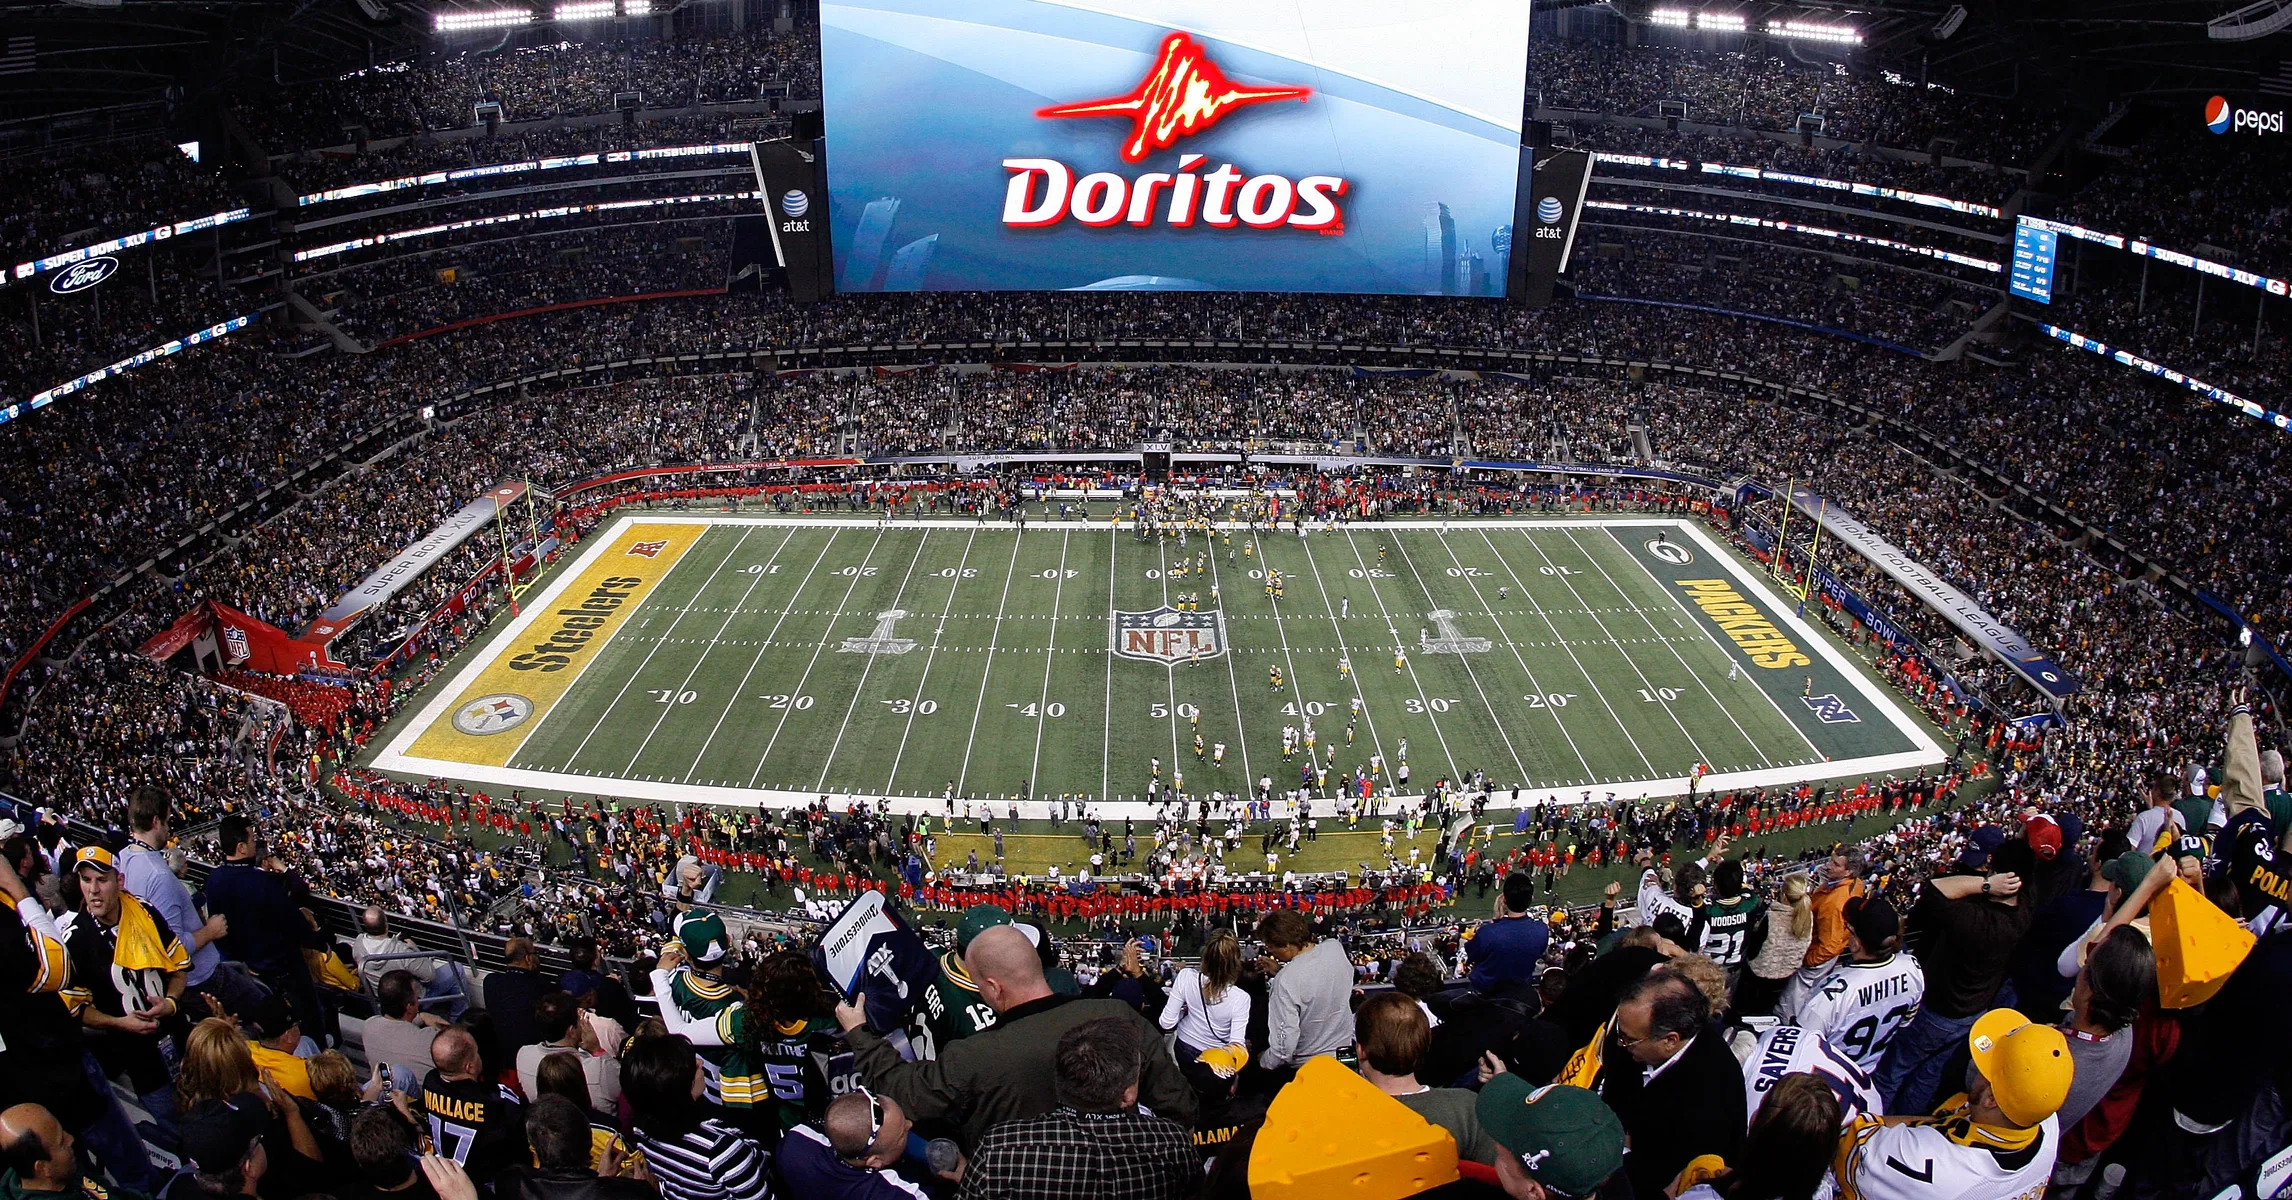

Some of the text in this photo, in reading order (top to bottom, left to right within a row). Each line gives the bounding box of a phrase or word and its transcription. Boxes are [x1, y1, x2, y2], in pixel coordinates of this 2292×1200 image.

[2234, 108, 2284, 136] pepsi
[638, 144, 713, 160] PITTSBURGH
[1596, 152, 1651, 166] PACKERS
[449, 161, 537, 180] NORTH TEXAS 02.06.11
[1762, 171, 1788, 181] NORTH
[1789, 174, 1814, 185] TEXAS
[1002, 154, 1348, 230] Doritos
[782, 219, 810, 233] at&t
[1535, 226, 1562, 240] at&t
[44, 249, 86, 271] SUPER
[89, 239, 124, 258] BOWL
[123, 232, 147, 249] XLV
[62, 262, 108, 289] Ford
[2154, 249, 2193, 268] SUPER
[2196, 258, 2231, 278] BOWL
[2232, 269, 2259, 287] XLV
[1536, 464, 1563, 472] NATIONAL
[363, 513, 477, 596] SUPER BOWL XLV
[1823, 507, 2024, 655] NATIONAL FOOTBALL LEAGUE
[1811, 567, 1898, 642] SUPER BOWL
[508, 575, 642, 673] Steelers
[1674, 578, 1811, 669] PACKERS
[229, 639, 249, 659] NFL
[1126, 629, 1212, 656] NFL
[654, 689, 698, 705] 10
[768, 694, 815, 711] 20
[890, 699, 939, 716] 30
[1404, 697, 1452, 714] 30
[1522, 692, 1570, 709] 20
[1636, 686, 1679, 703] 10
[1019, 702, 1067, 718] 40
[1149, 702, 1196, 718] 50
[1279, 700, 1326, 717] 40
[2249, 864, 2290, 901] POLA
[829, 903, 880, 959] BRIDGESTONE
[1710, 912, 1747, 927] WOODSON
[1857, 973, 1909, 1008] WHITE
[965, 1003, 997, 1032] 12
[1841, 1002, 1910, 1062] 92
[1754, 1027, 1801, 1092] SAYERS
[424, 1088, 485, 1123] WALLACE
[427, 1112, 478, 1168] 17
[1885, 1154, 1934, 1185] 7
